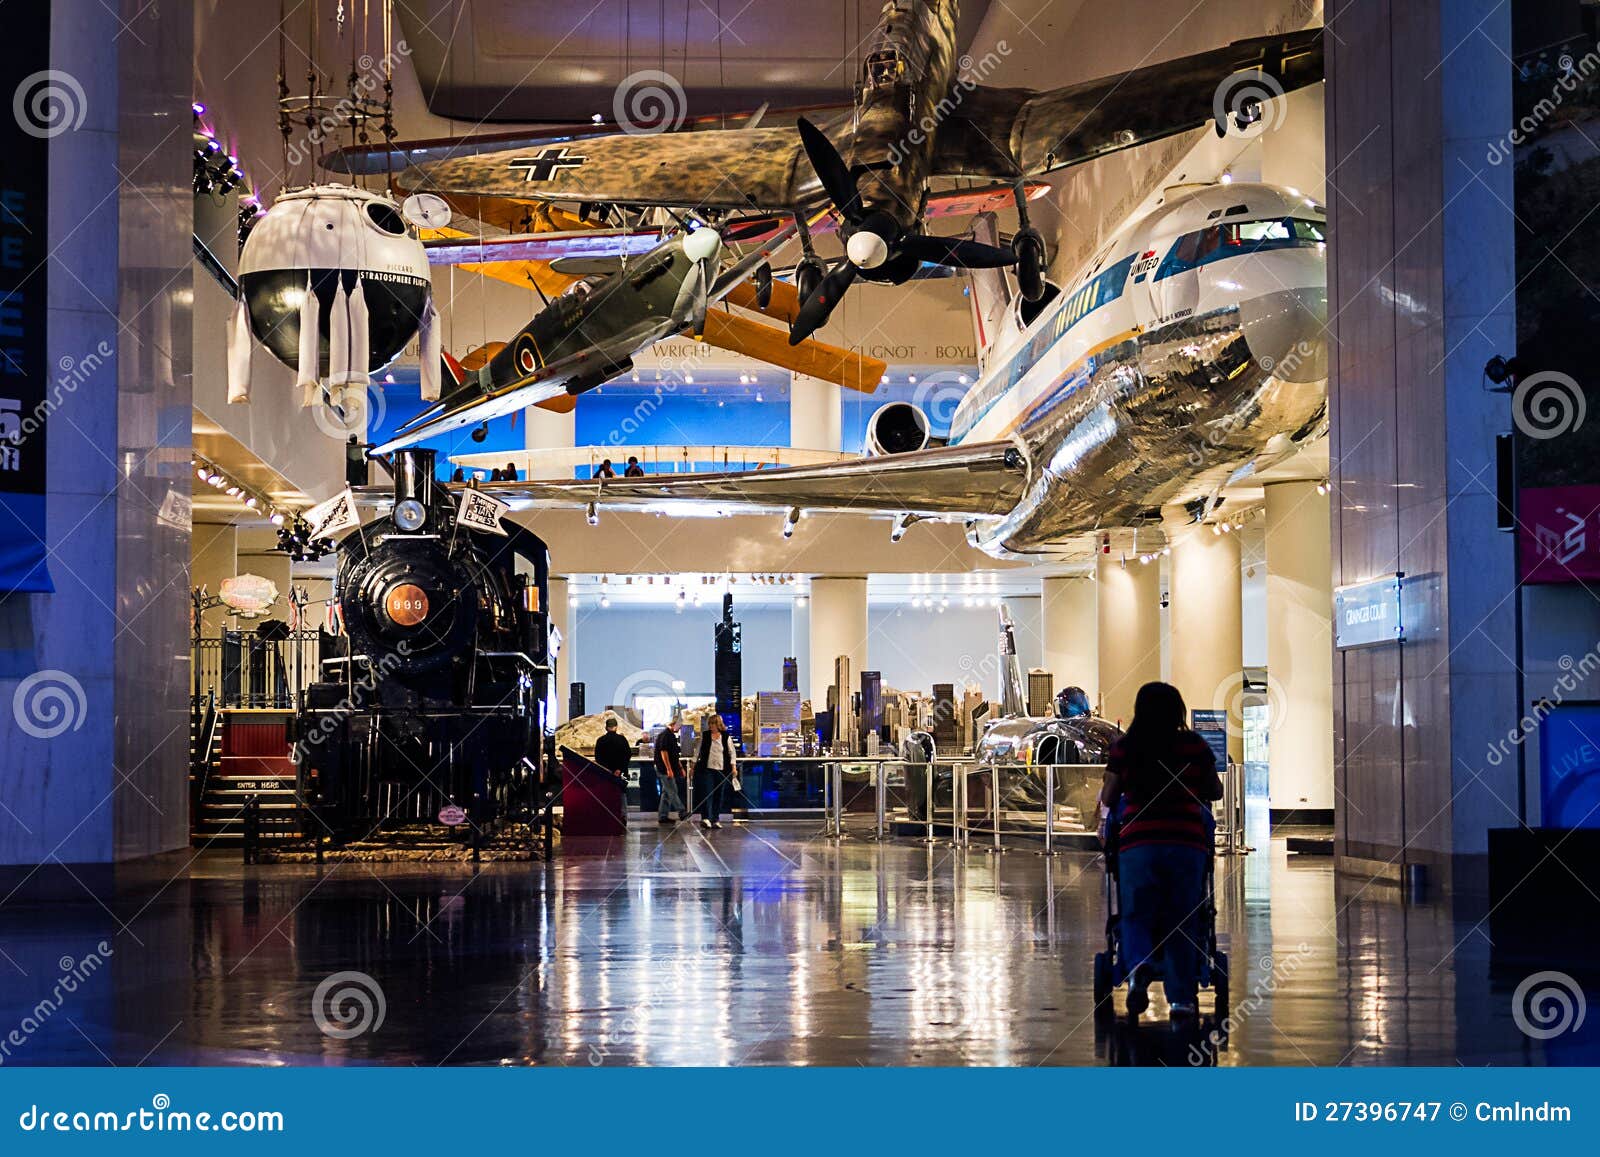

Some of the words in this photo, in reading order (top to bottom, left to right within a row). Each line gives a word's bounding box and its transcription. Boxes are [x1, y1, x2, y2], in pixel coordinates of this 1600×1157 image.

[1131, 257, 1160, 276] UNITED
[360, 272, 411, 284] STRATOSPHERE
[393, 599, 422, 610] 999
[1551, 744, 1595, 780] LIVE
[261, 781, 280, 789] HERE
